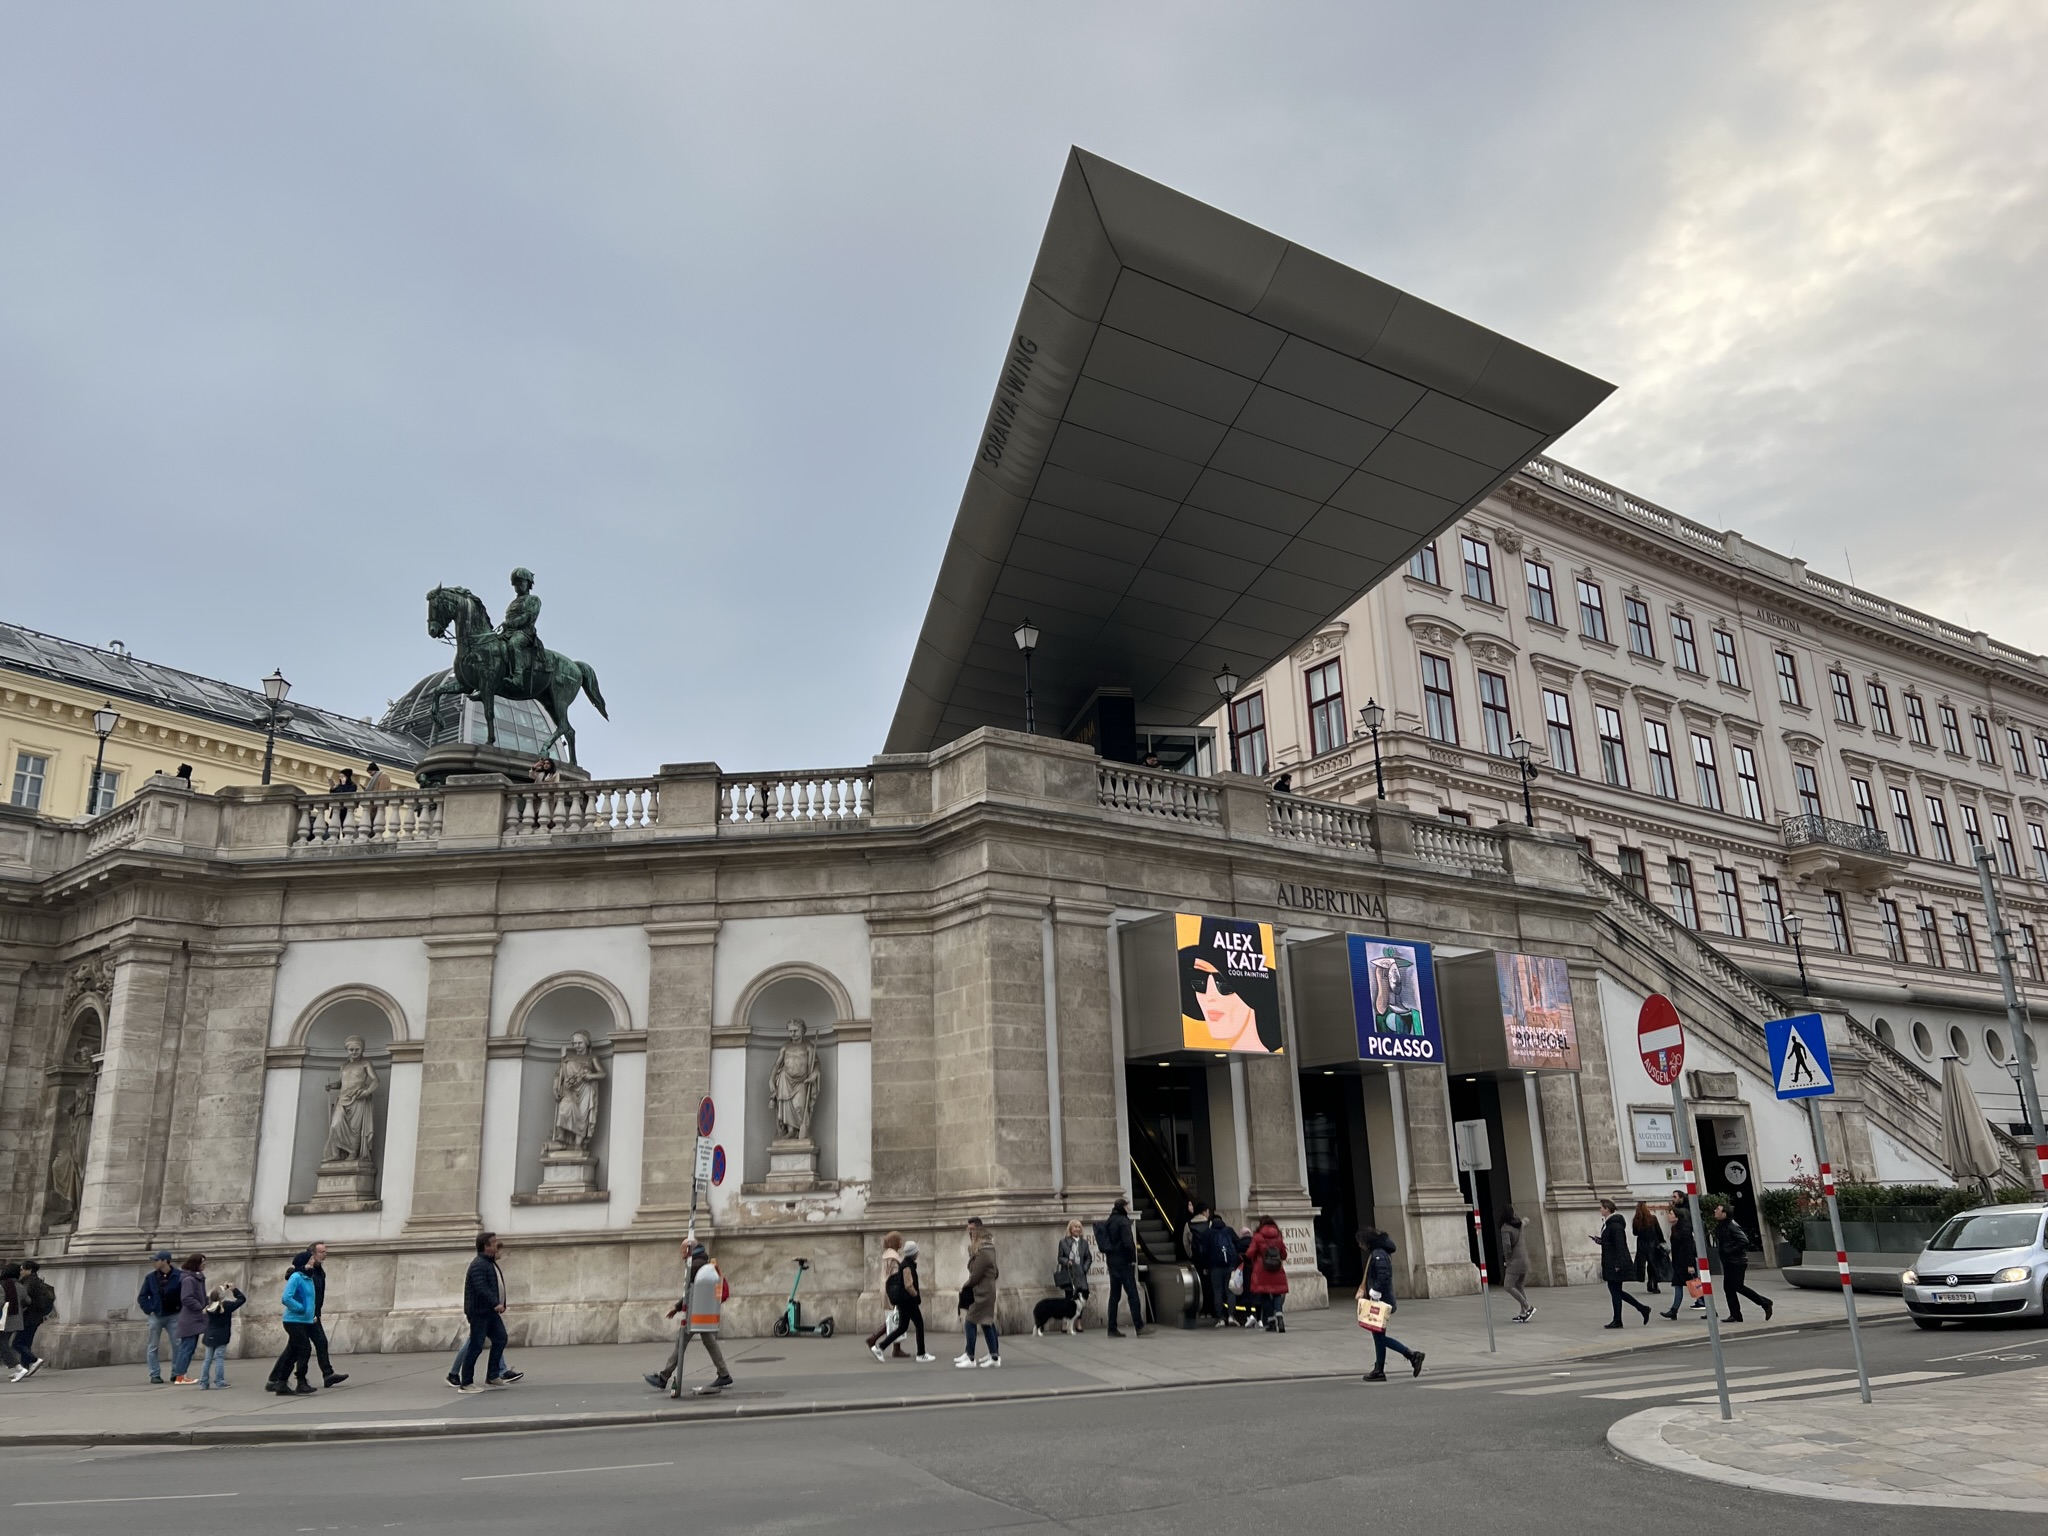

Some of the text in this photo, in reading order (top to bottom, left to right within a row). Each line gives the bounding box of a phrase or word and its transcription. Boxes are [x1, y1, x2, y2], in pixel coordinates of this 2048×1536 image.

[982, 335, 1038, 469] SORAVIA WING
[1277, 883, 1387, 919] ALBERTINA
[1213, 931, 1254, 952] ALEX
[1226, 951, 1269, 972] KATZ
[1228, 969, 1269, 979] COOL PAINTING
[1368, 1036, 1434, 1058] PICASSO
[1644, 1058, 1671, 1083] AUSGEN.
